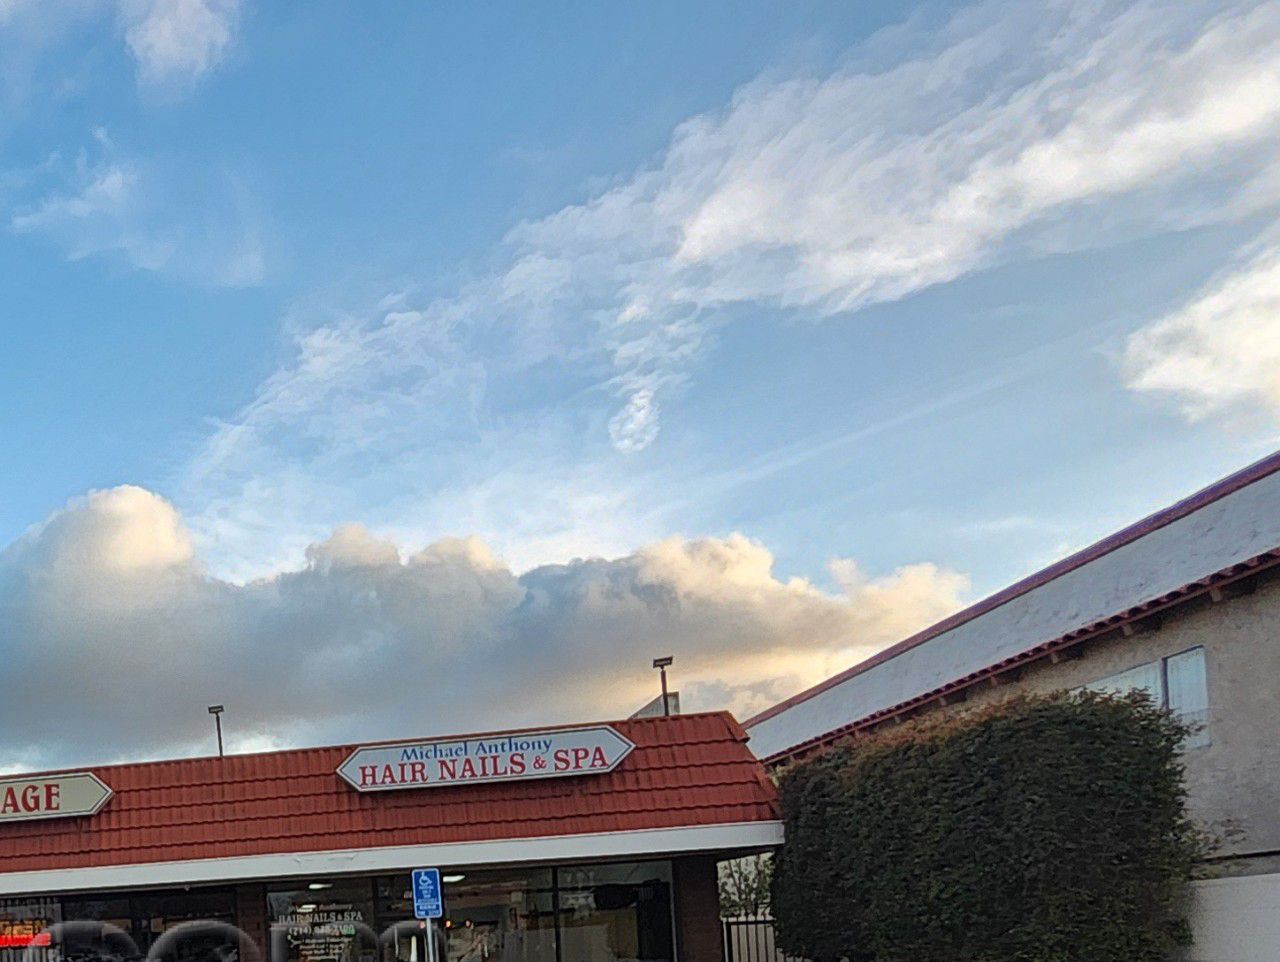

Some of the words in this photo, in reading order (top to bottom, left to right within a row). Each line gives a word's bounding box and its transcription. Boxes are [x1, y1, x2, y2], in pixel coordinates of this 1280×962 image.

[401, 741, 469, 761] Michael
[475, 737, 553, 758] Anthony
[359, 762, 428, 786] HAIR
[438, 753, 526, 781] NAILS
[533, 755, 547, 770] &
[554, 746, 609, 772] SPA
[344, 911, 363, 921] SPA
